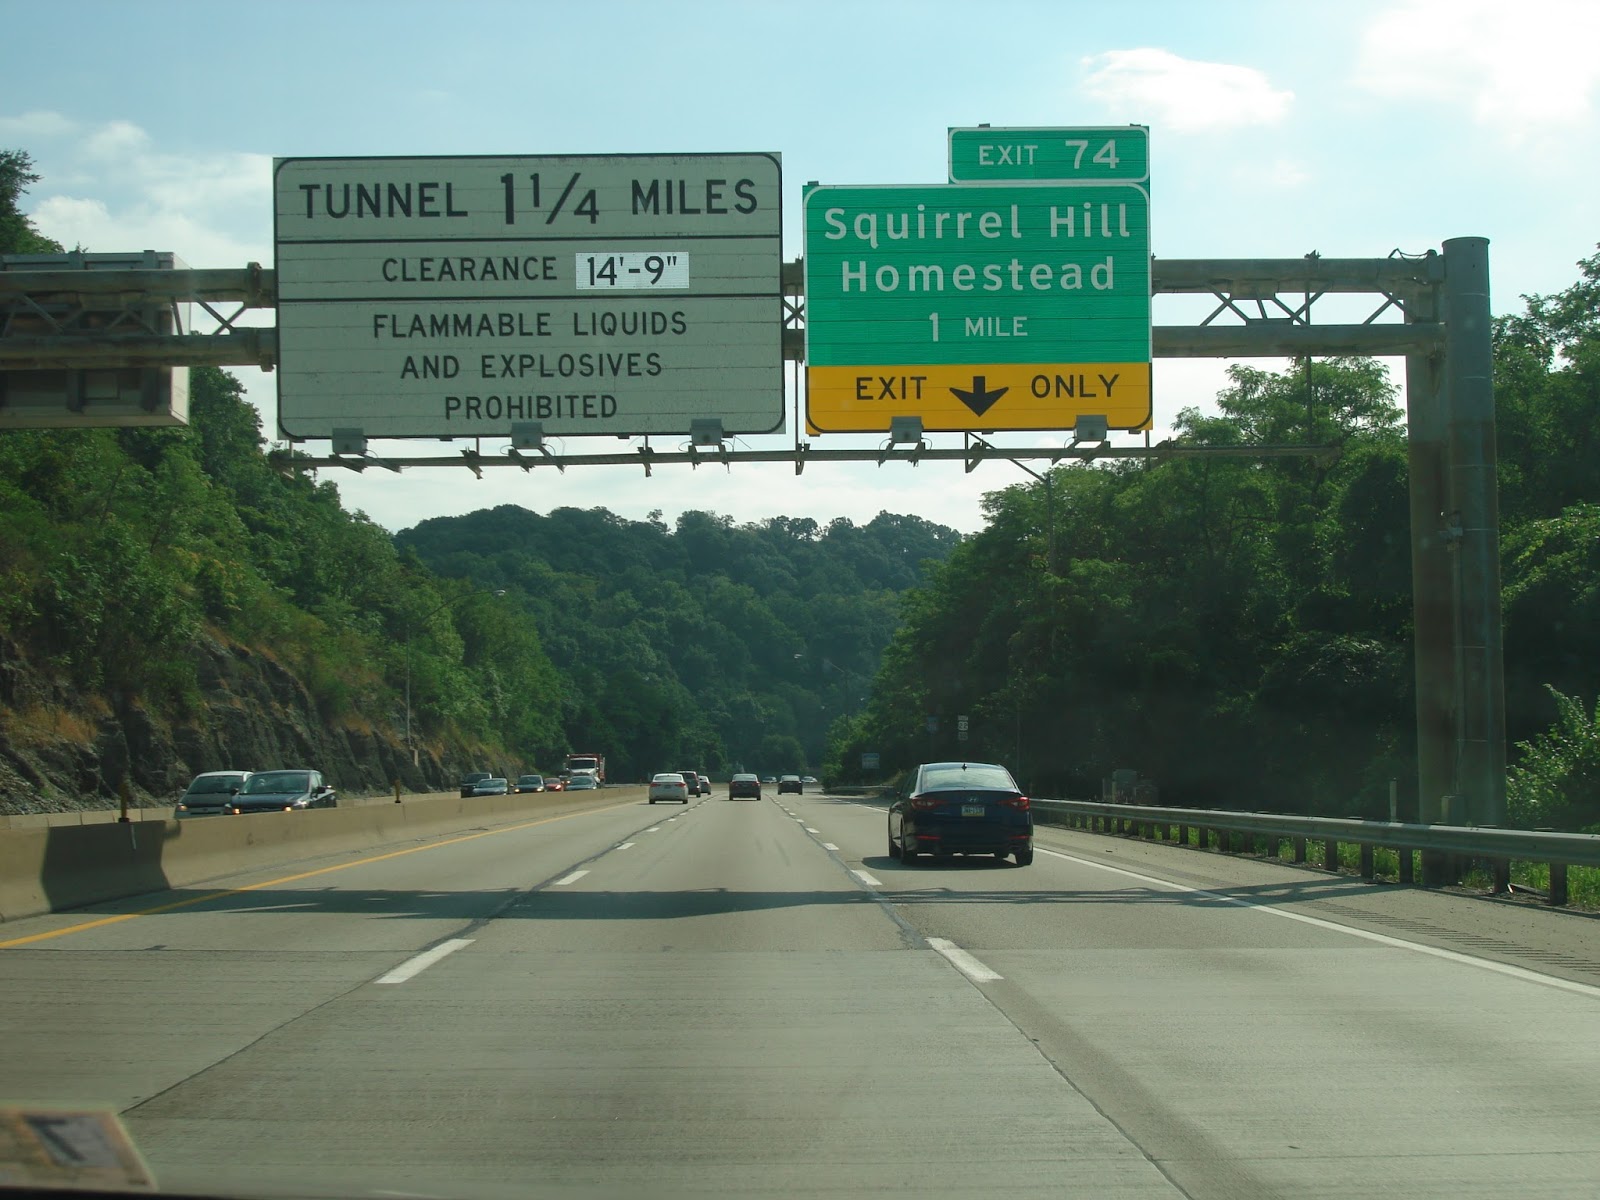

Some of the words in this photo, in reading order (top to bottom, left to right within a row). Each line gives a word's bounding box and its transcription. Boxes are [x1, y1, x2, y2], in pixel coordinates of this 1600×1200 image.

[978, 144, 1039, 166] EXIT
[1065, 139, 1120, 169] 74
[299, 182, 469, 219] TUNNEL
[631, 178, 758, 216] MILES
[824, 204, 1022, 249] Squirrel
[1050, 202, 1130, 238] Hill
[382, 256, 558, 283] CLEARANCE
[842, 256, 1114, 292] Homestead
[373, 312, 552, 339] FLAMMABLE
[573, 311, 687, 337] LIQUIDS
[928, 312, 939, 342] 1
[965, 316, 1028, 337] MILE
[400, 355, 460, 380] AND
[481, 352, 662, 379] EXPLOSIVES
[856, 376, 927, 401] EXIT
[1030, 373, 1120, 399] ONLY
[445, 394, 617, 421] PROHIBITED
